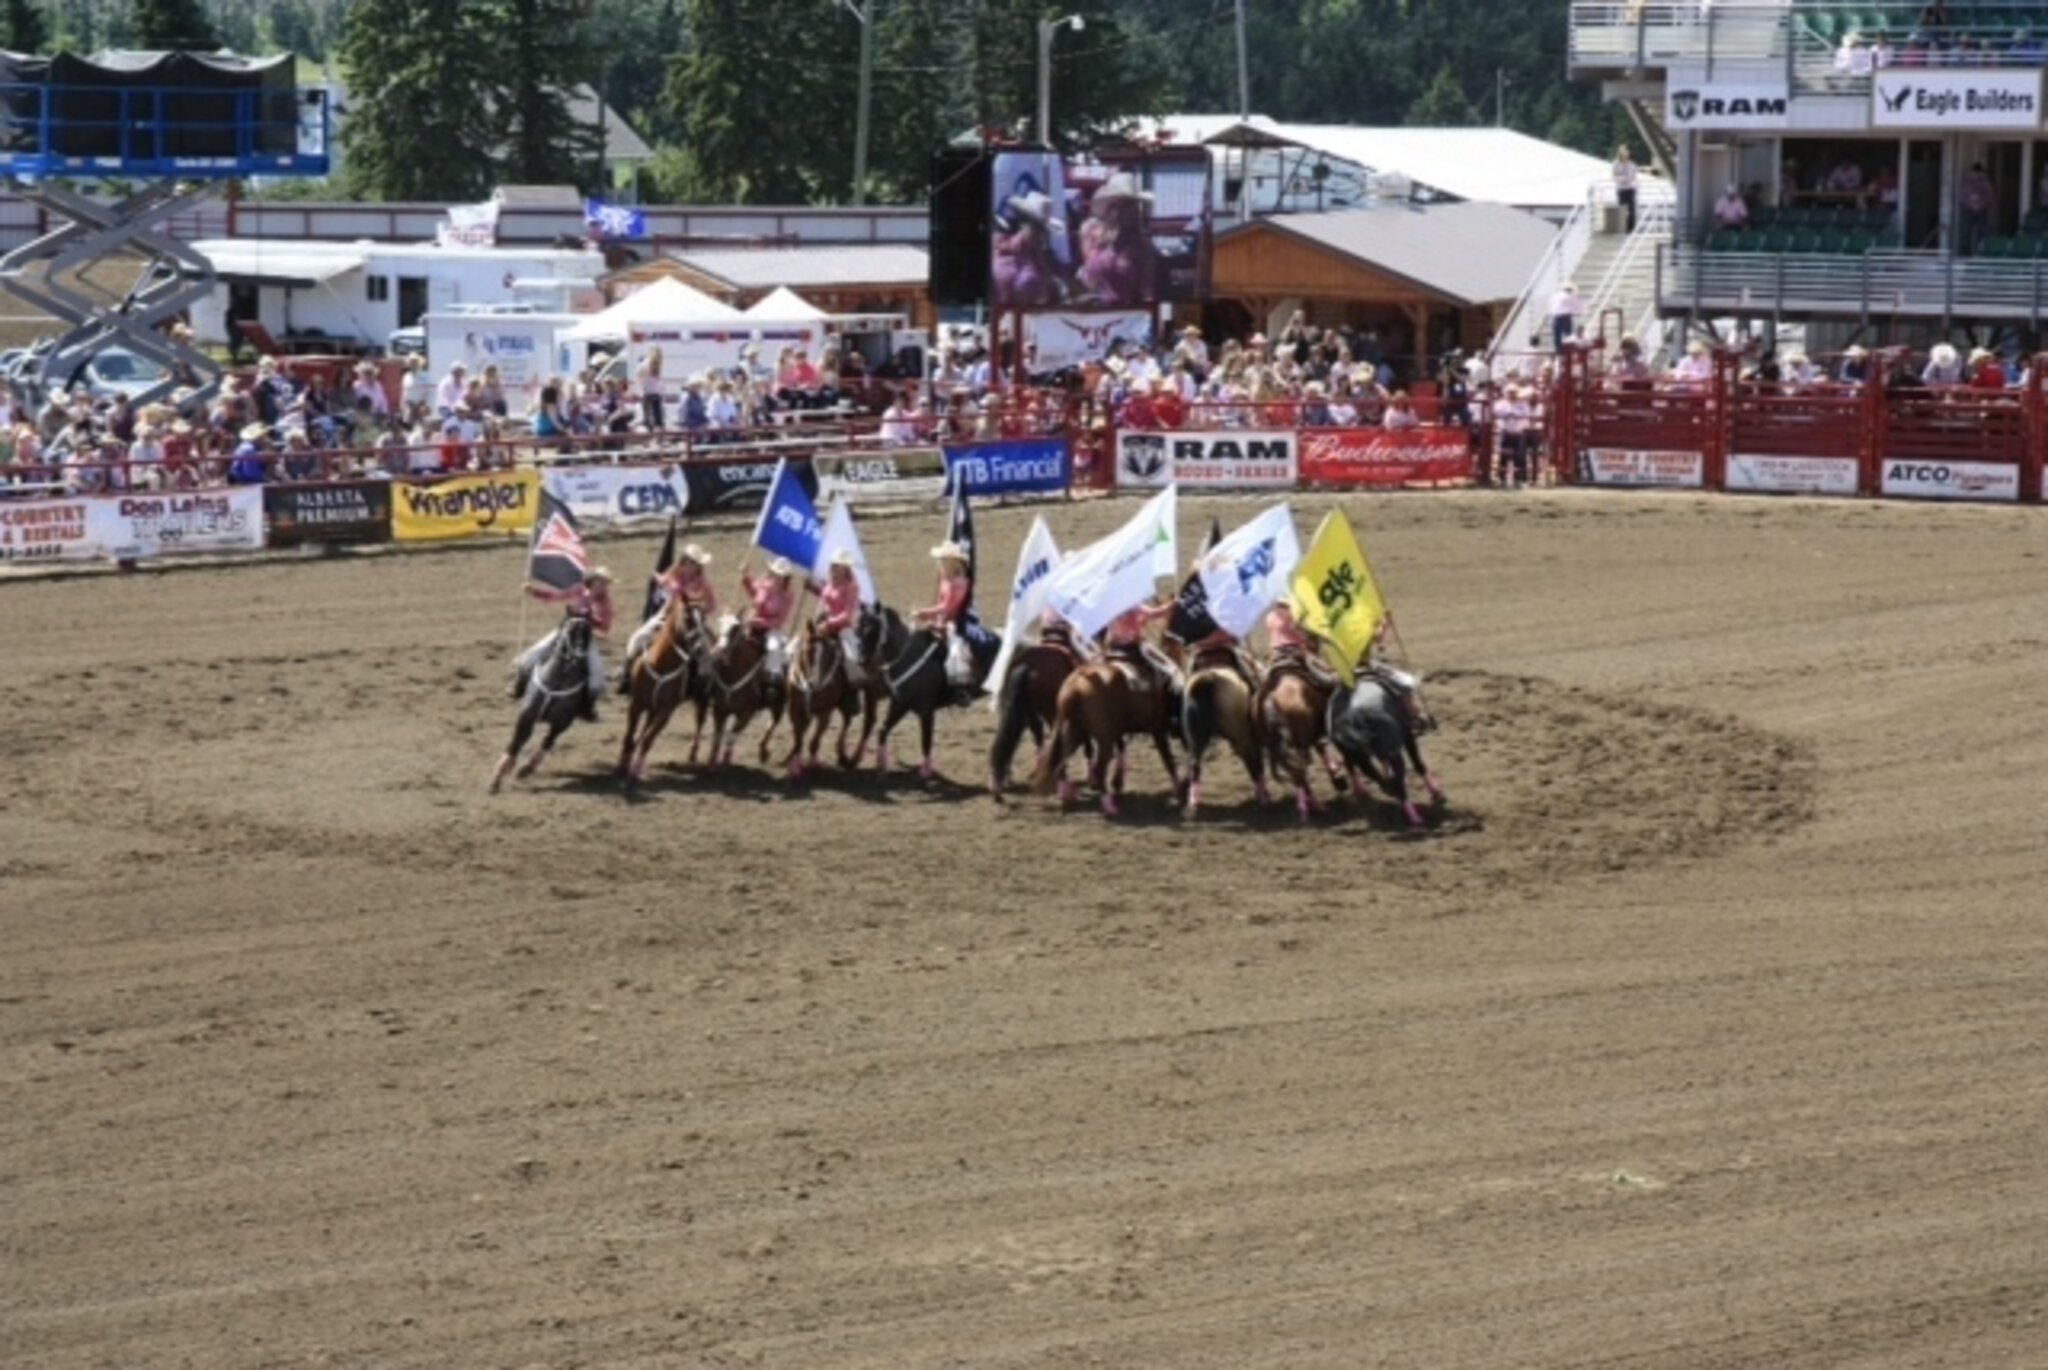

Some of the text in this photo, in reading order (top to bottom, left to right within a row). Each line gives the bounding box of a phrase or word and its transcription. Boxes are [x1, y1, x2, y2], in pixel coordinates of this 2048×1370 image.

[1702, 98, 1786, 116] RAM
[1916, 88, 2033, 116] Eagle Builders
[1173, 440, 1288, 459] RAM
[1302, 431, 1467, 462] Budweiser
[950, 451, 1063, 484] TB Financial
[1888, 463, 1950, 482] ATCO
[297, 488, 365, 507] ALBERTA
[402, 480, 526, 527] Wrangler
[1, 504, 86, 527] COUNTRY
[119, 498, 164, 517] Don
[297, 505, 369, 523] PREMIUM
